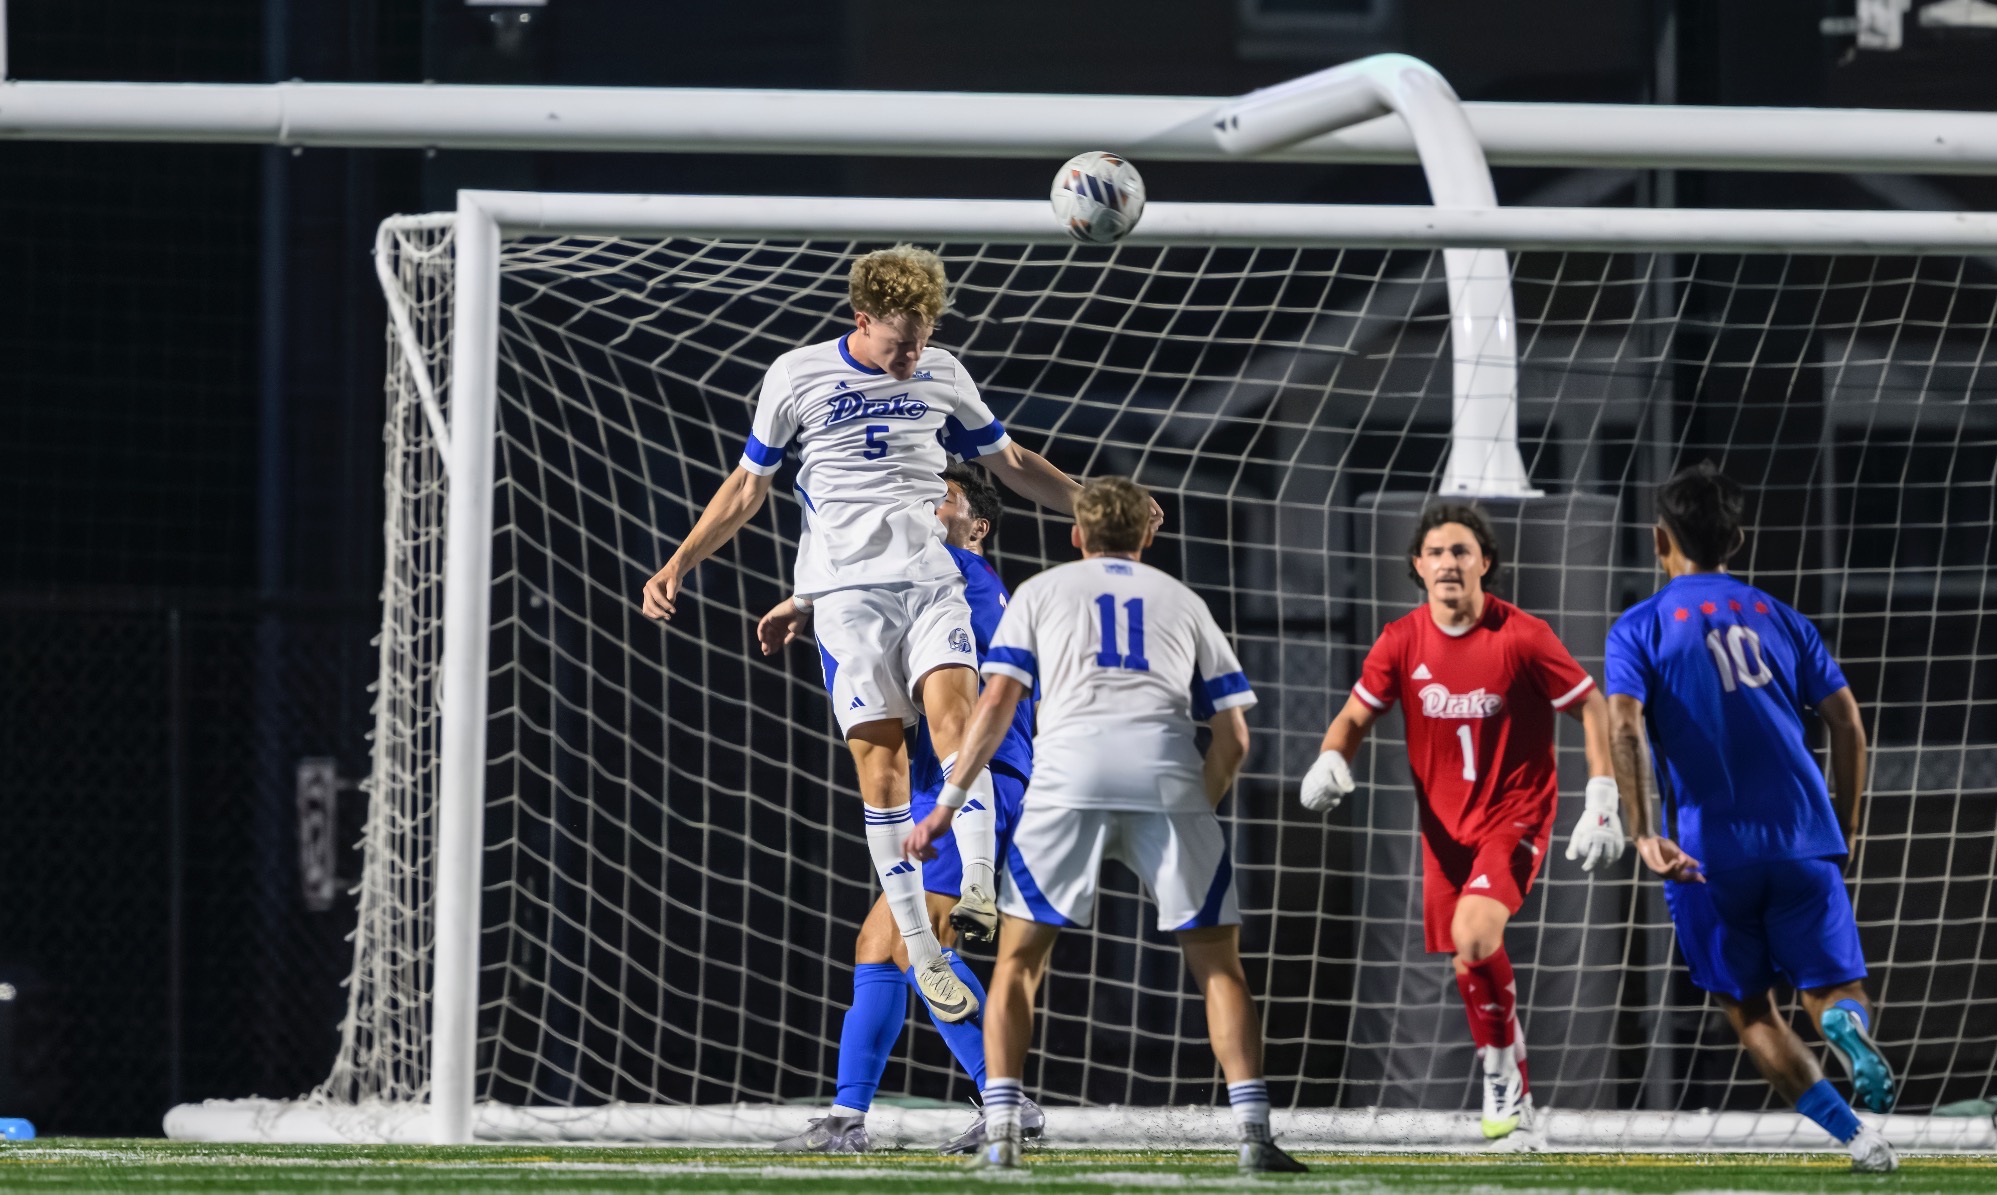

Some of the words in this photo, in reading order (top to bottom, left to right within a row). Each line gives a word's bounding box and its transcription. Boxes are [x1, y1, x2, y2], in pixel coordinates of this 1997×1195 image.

[825, 391, 929, 426] Drake
[863, 425, 890, 461] 5
[1095, 593, 1149, 672] 11
[1706, 624, 1773, 692] 10
[1418, 683, 1502, 718] Drake
[1456, 724, 1476, 782] 1
